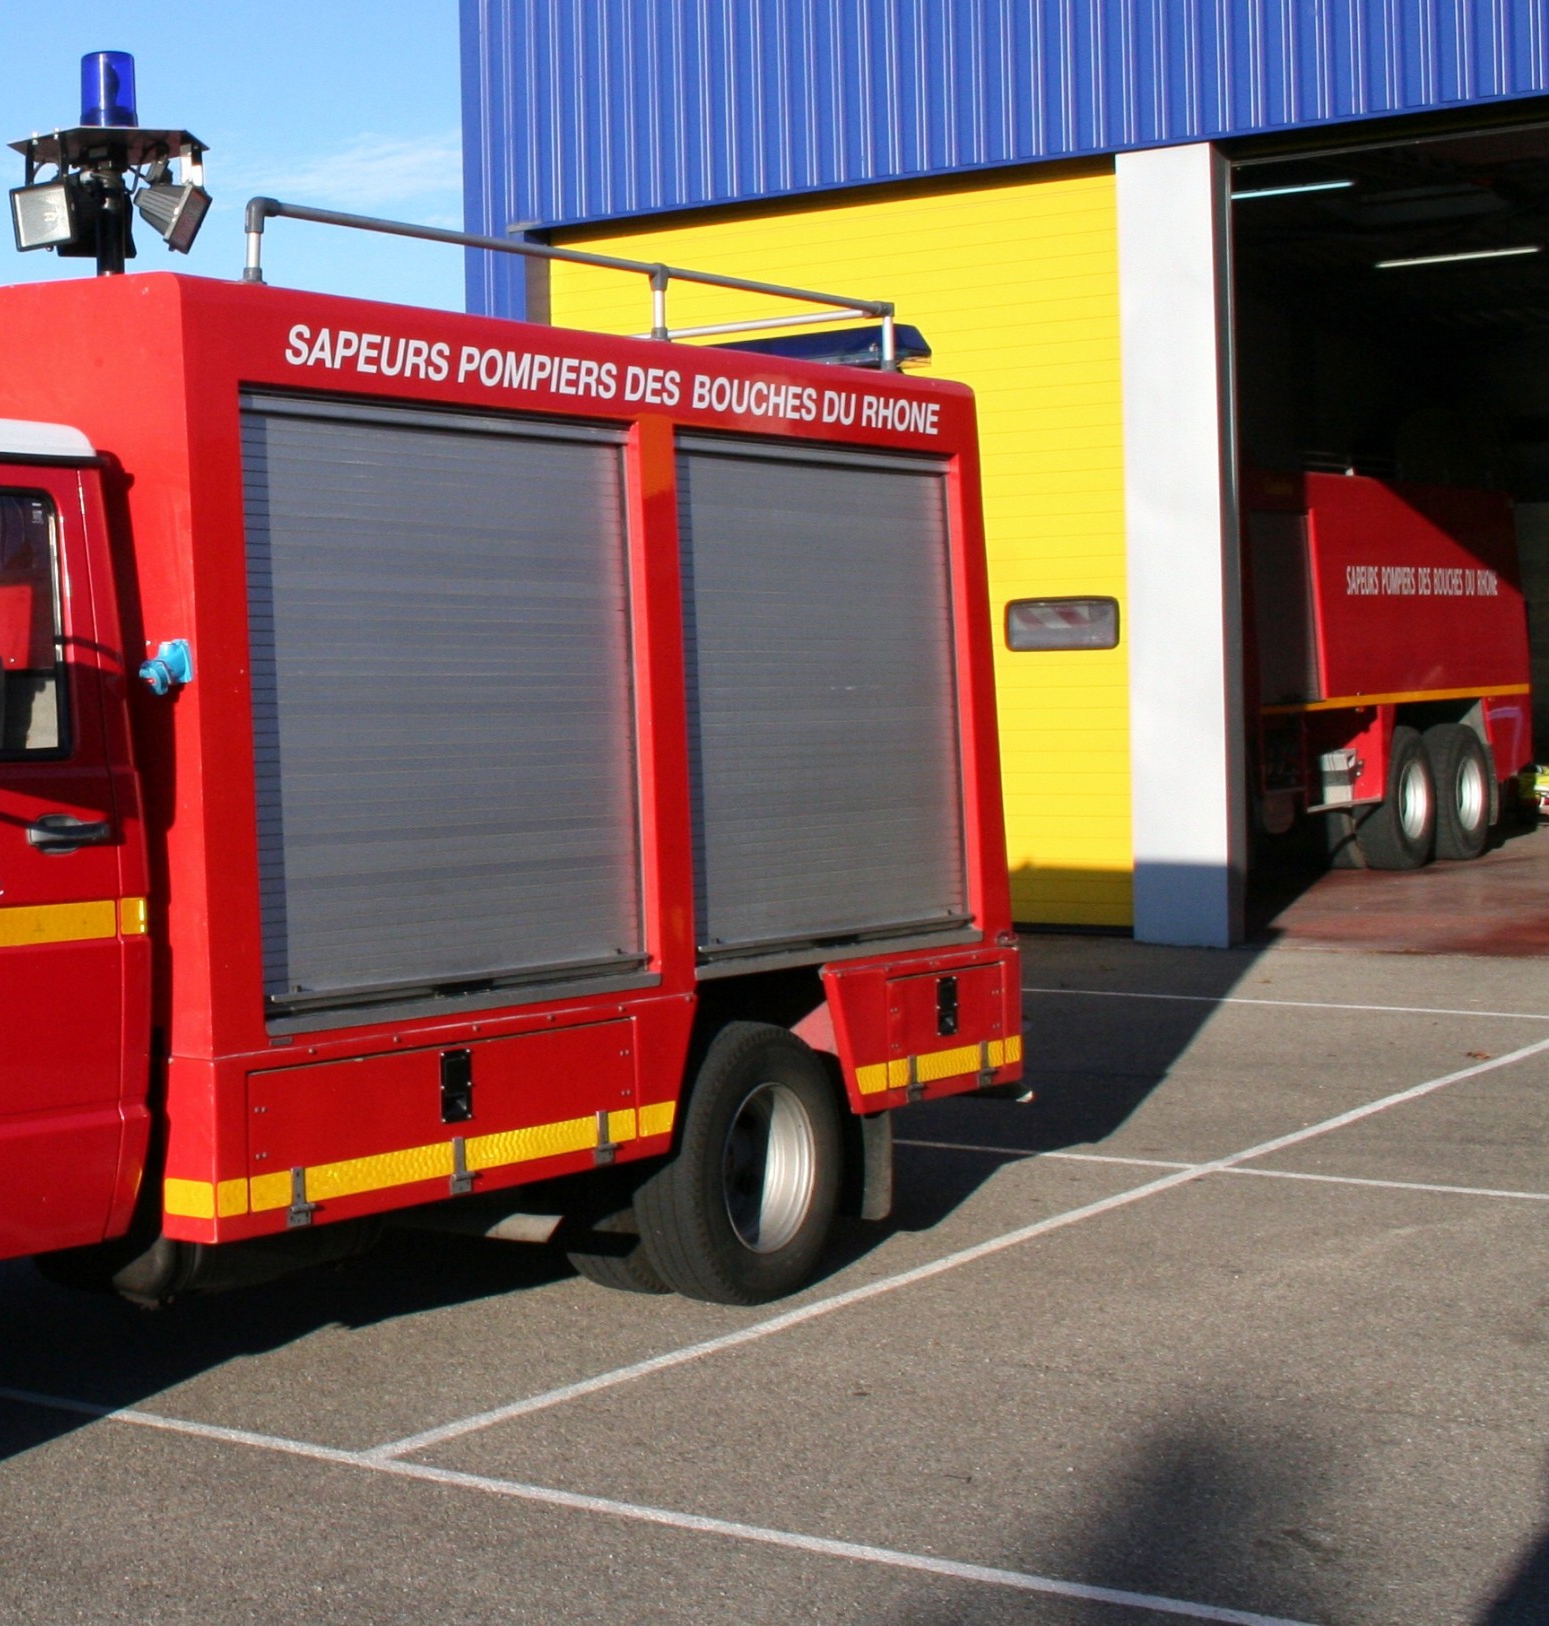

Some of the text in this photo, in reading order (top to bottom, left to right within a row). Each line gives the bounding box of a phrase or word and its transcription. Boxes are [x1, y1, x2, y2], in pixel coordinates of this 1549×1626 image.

[284, 323, 940, 435] SAPEURS POMPIERS DES BOUCHES DU RHONE
[1346, 565, 1379, 595] SAPEURS
[1381, 566, 1416, 595] POMPIERS
[1418, 567, 1432, 596] DES
[1434, 567, 1464, 596] BOUCHES
[1465, 568, 1475, 596] DU
